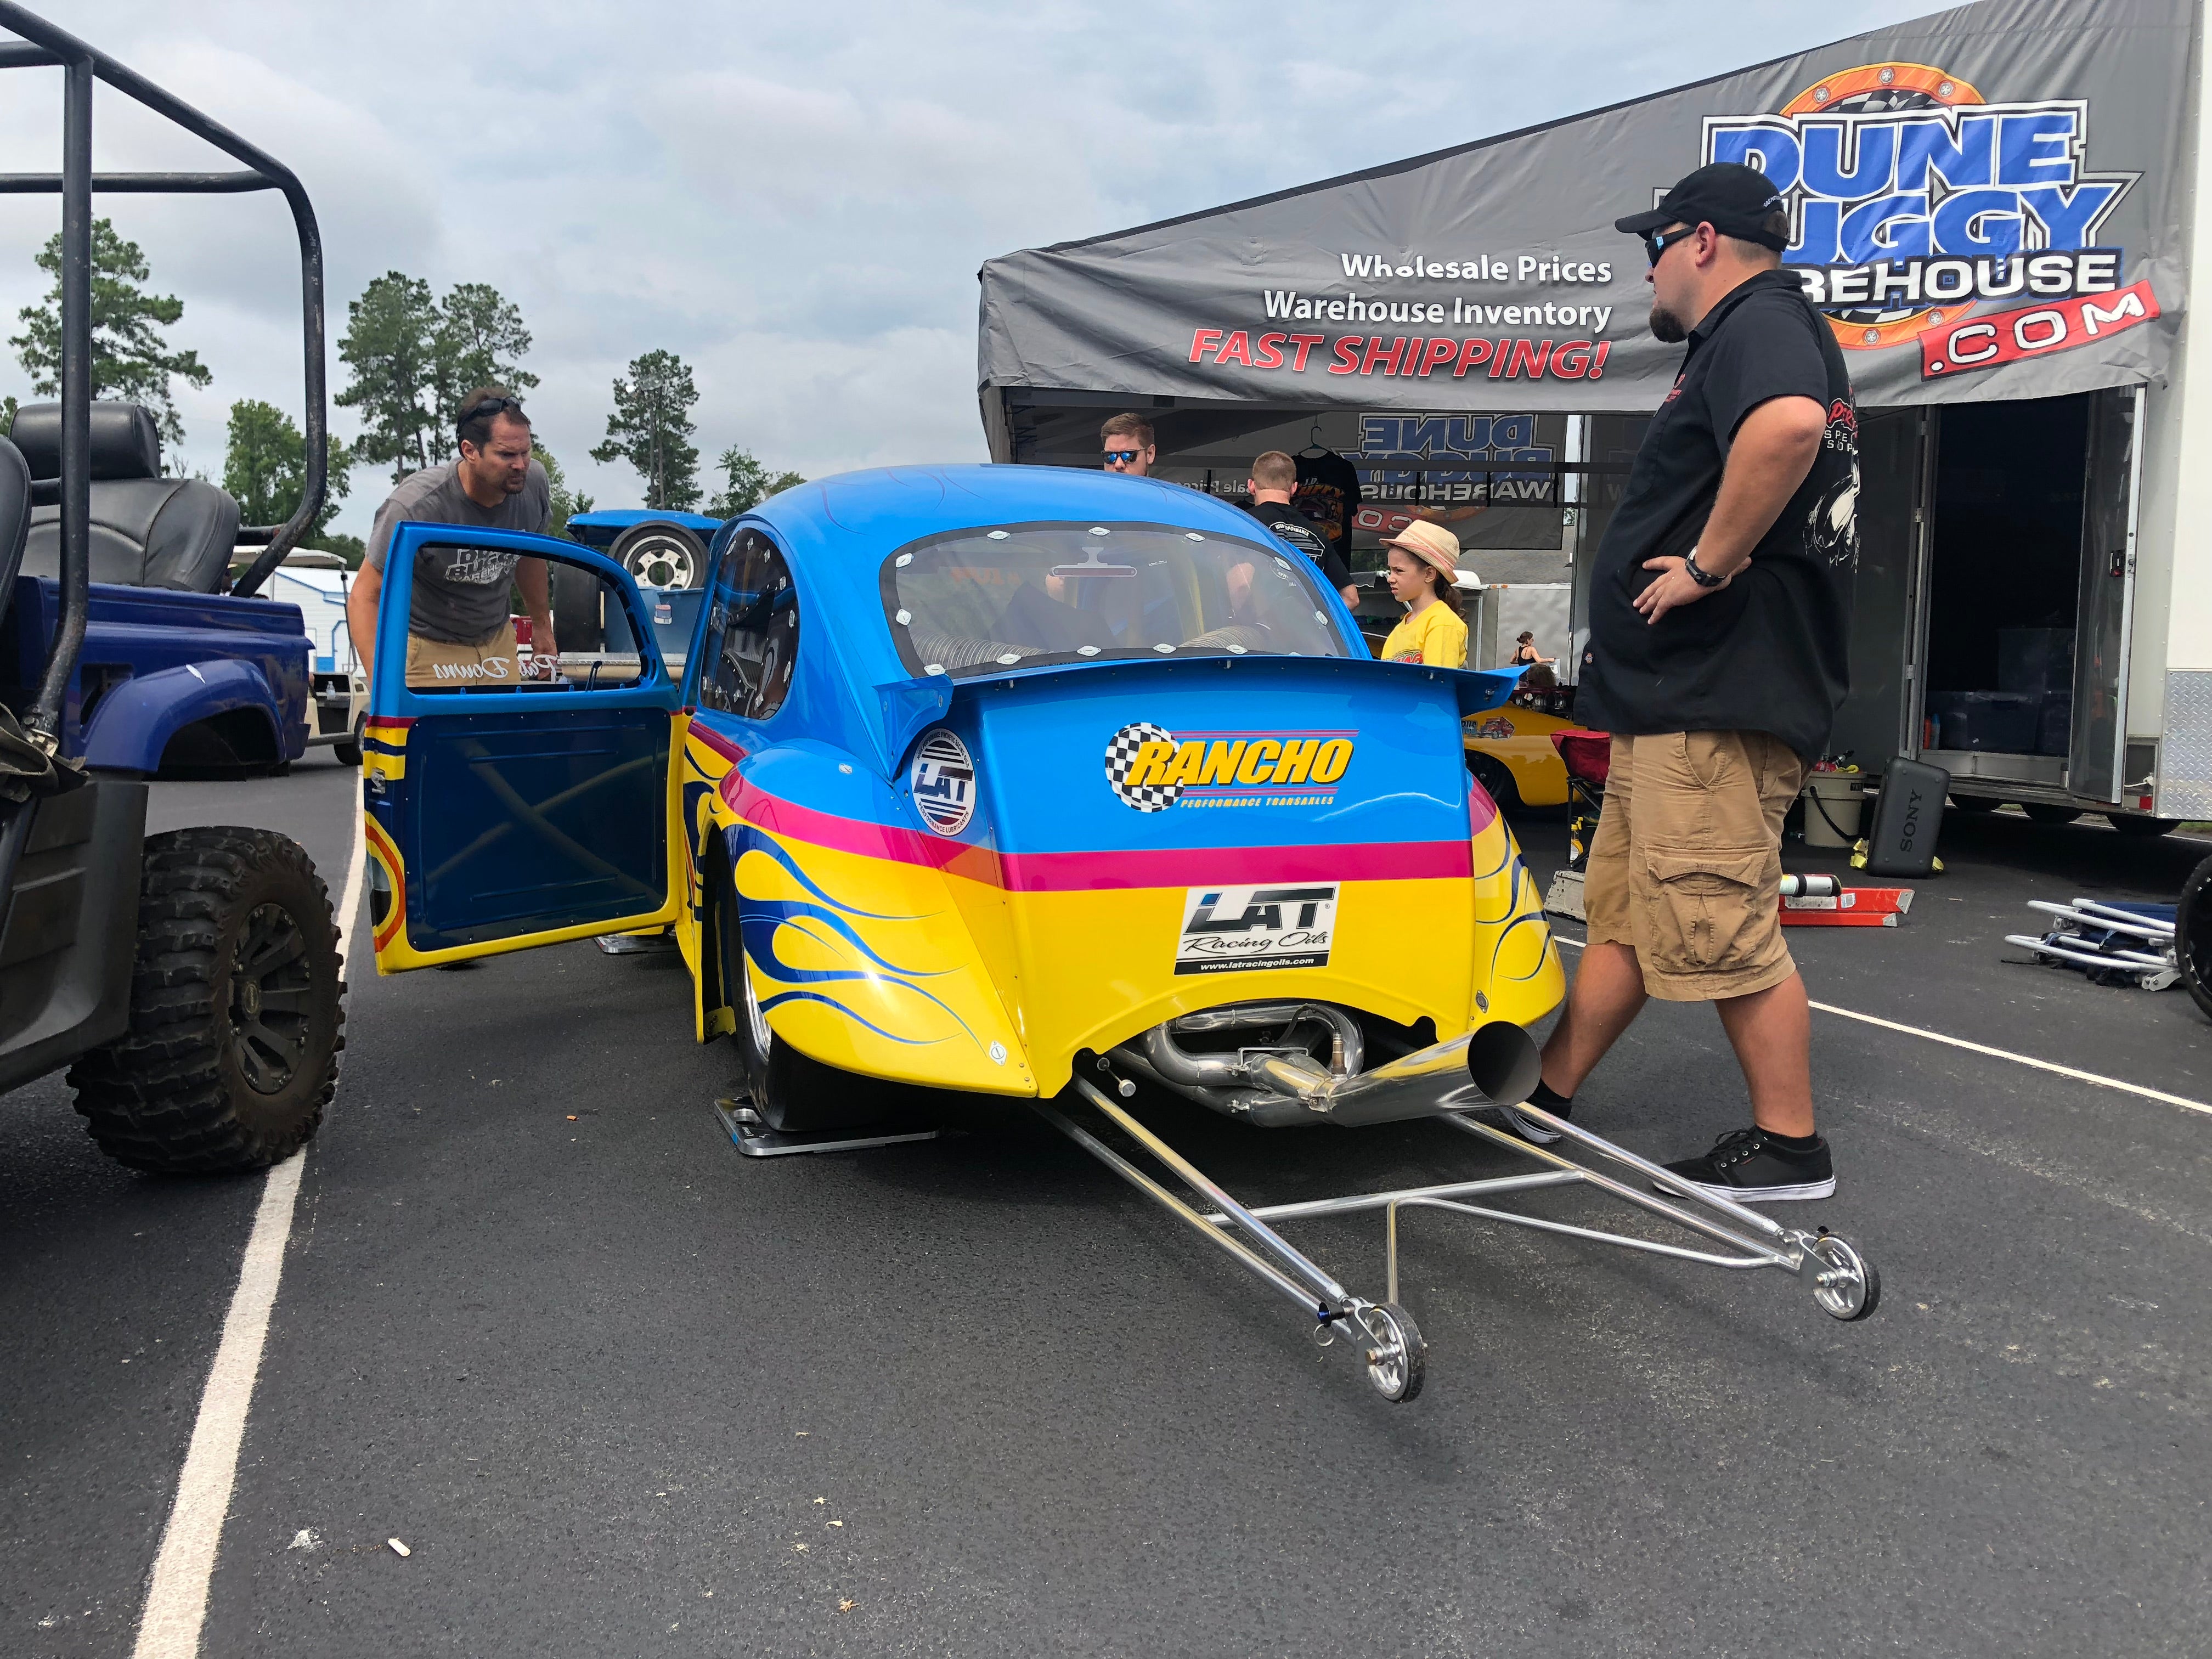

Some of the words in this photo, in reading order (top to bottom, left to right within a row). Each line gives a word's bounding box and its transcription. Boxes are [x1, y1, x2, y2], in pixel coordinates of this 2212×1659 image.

[1707, 109, 2079, 201] DUNE
[1781, 181, 2122, 264] UGGY
[1341, 253, 1509, 281] Wholesale
[1518, 255, 1612, 283] Prices
[1802, 254, 2117, 303] REHOUSE
[1263, 289, 1445, 324] Warehouse
[1454, 296, 1612, 334] Inventory
[1929, 292, 2146, 373] .COM
[1188, 328, 1324, 371] FAST
[1327, 334, 1612, 380] SHIPPING!
[955, 739, 966, 757] RACING
[1124, 738, 1354, 786] RANCHO
[913, 763, 974, 802] LAT
[1180, 798, 1262, 809] PERFORMANCE
[1265, 795, 1335, 806] TRANSAXLES
[918, 801, 945, 833] PERFORMANCE
[945, 810, 969, 833] LUBRICANTS
[1900, 788, 1923, 853] SONY
[1182, 887, 1336, 935] LAT
[1182, 936, 1274, 954] Racing
[1278, 931, 1330, 947] Oils
[1200, 958, 1315, 970] www.latracingoils.com
